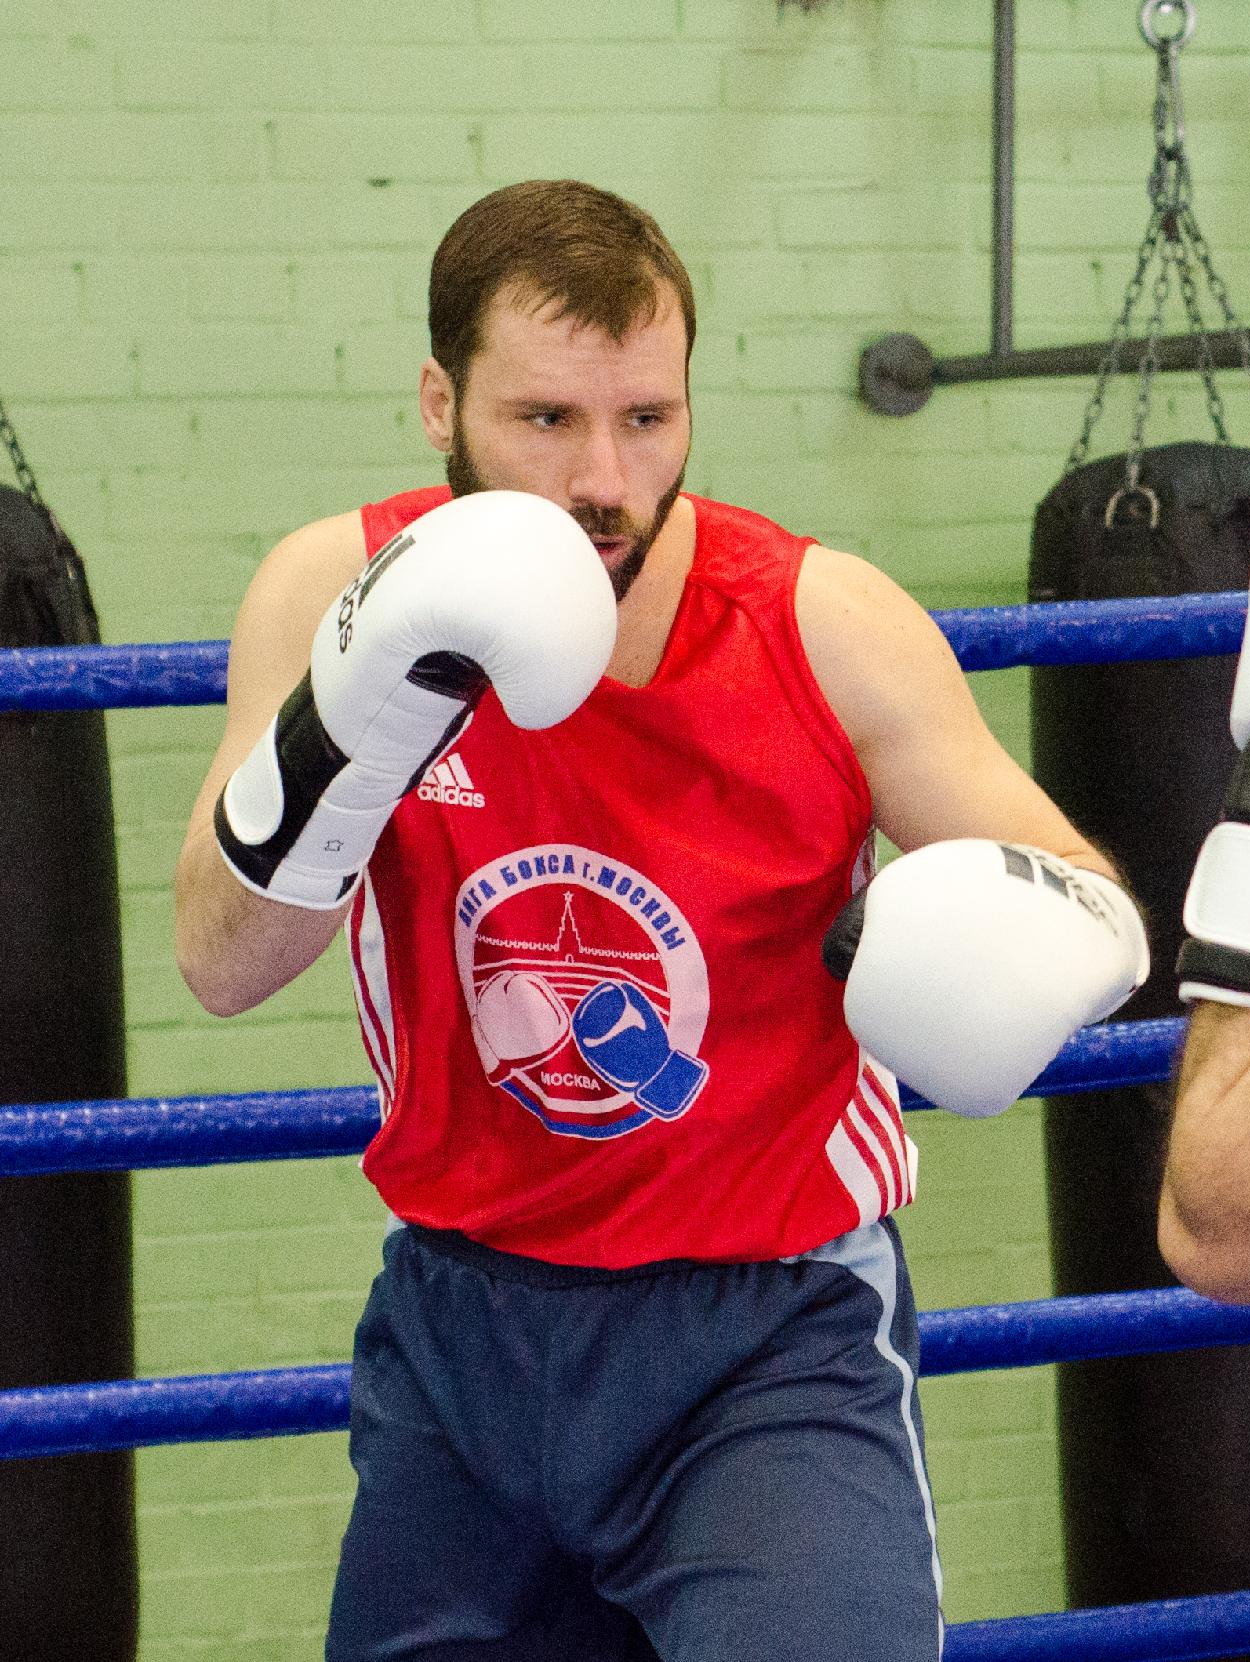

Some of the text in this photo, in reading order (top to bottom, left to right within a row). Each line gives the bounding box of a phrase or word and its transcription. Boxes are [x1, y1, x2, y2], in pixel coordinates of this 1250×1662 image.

[417, 782, 486, 809] adidas
[457, 879, 497, 928] ЛИГА
[500, 854, 576, 888] БОКСА
[540, 1071, 601, 1092] МОСКВА
